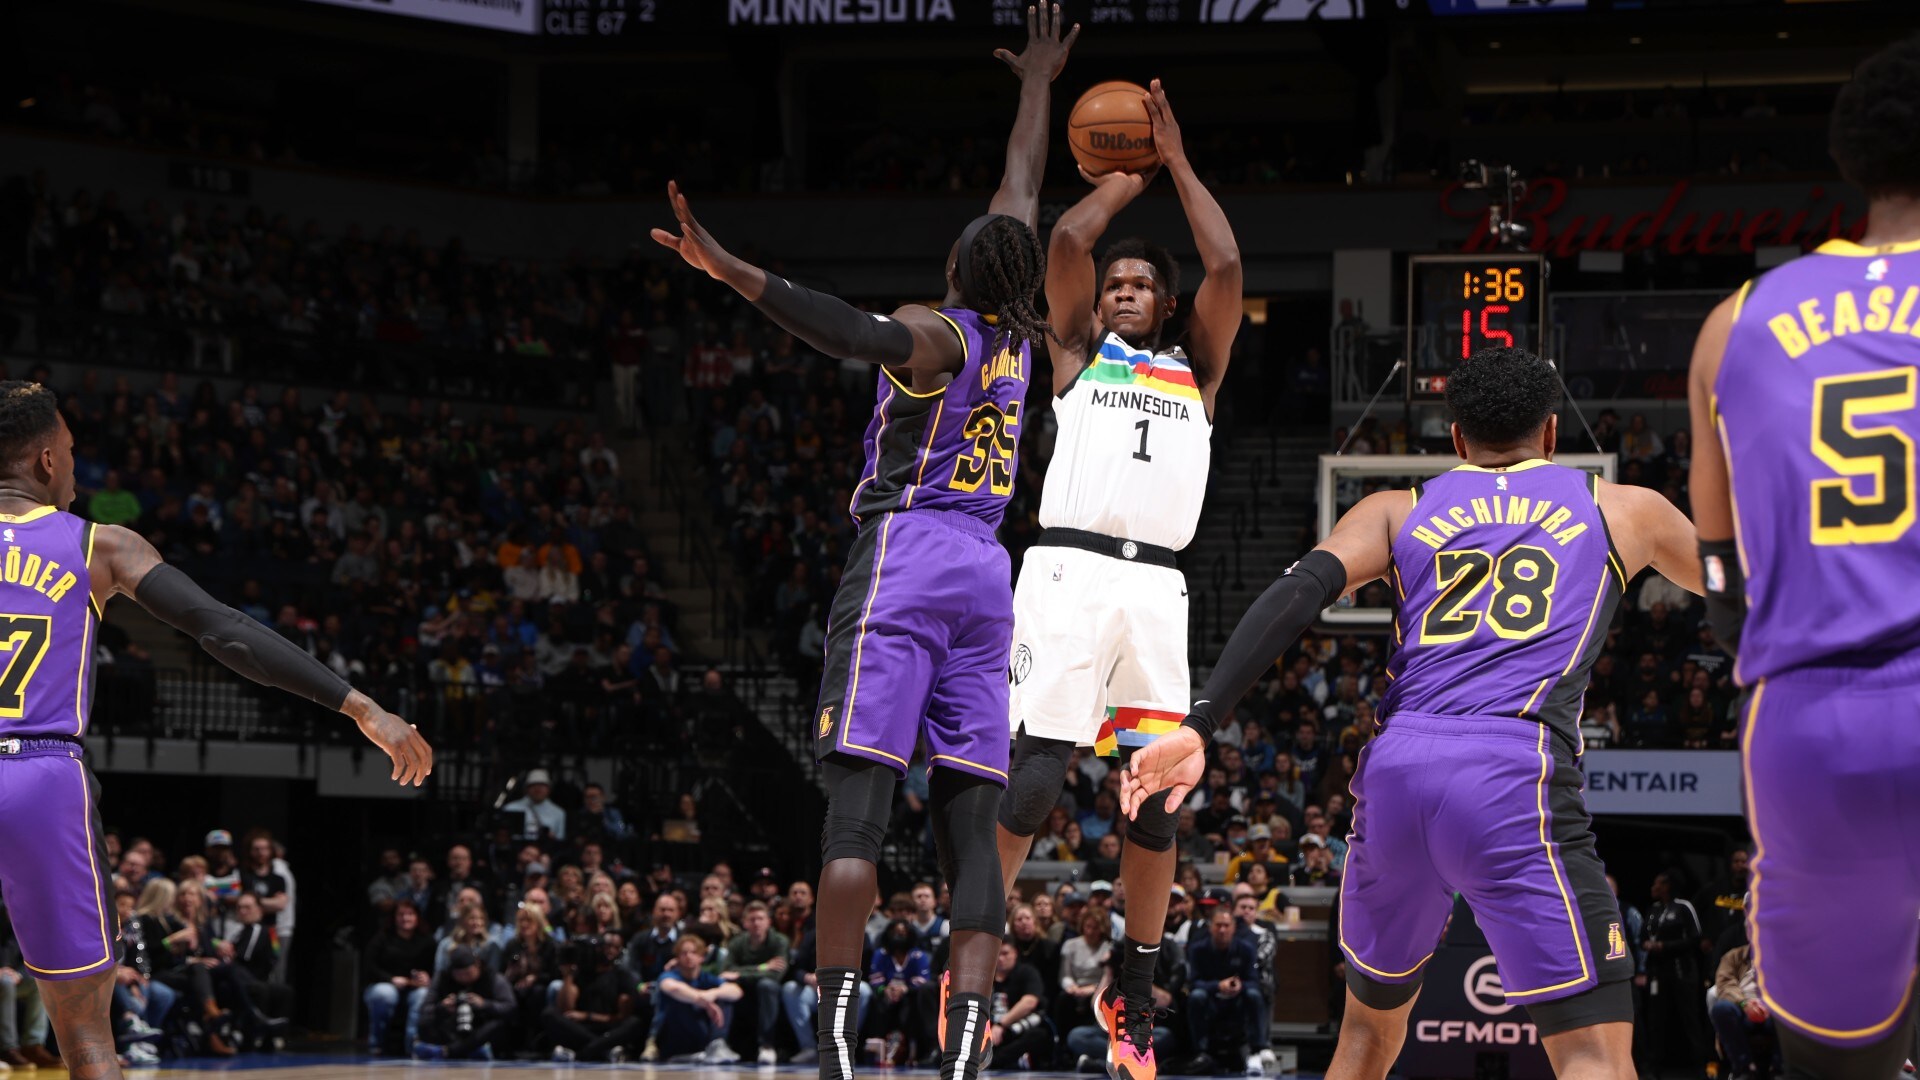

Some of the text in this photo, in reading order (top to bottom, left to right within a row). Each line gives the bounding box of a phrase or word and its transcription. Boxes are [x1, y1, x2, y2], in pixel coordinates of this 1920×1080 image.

[545, 10, 627, 36] CLE 67
[728, 0, 956, 26] MINNESOTA
[1089, 131, 1154, 149] Wilson
[1463, 267, 1525, 302] 1:36
[1462, 304, 1515, 360] 15
[1091, 388, 1190, 422] MINNESOTA
[948, 401, 1021, 496] 35
[1132, 419, 1152, 463] 1
[1810, 365, 1918, 546] 5
[1411, 495, 1588, 549] HACHIMURA
[0, 545, 78, 603] ÖDER
[1419, 544, 1560, 645] 28
[0, 613, 52, 718] 7
[1588, 772, 1699, 792] ENTAIR
